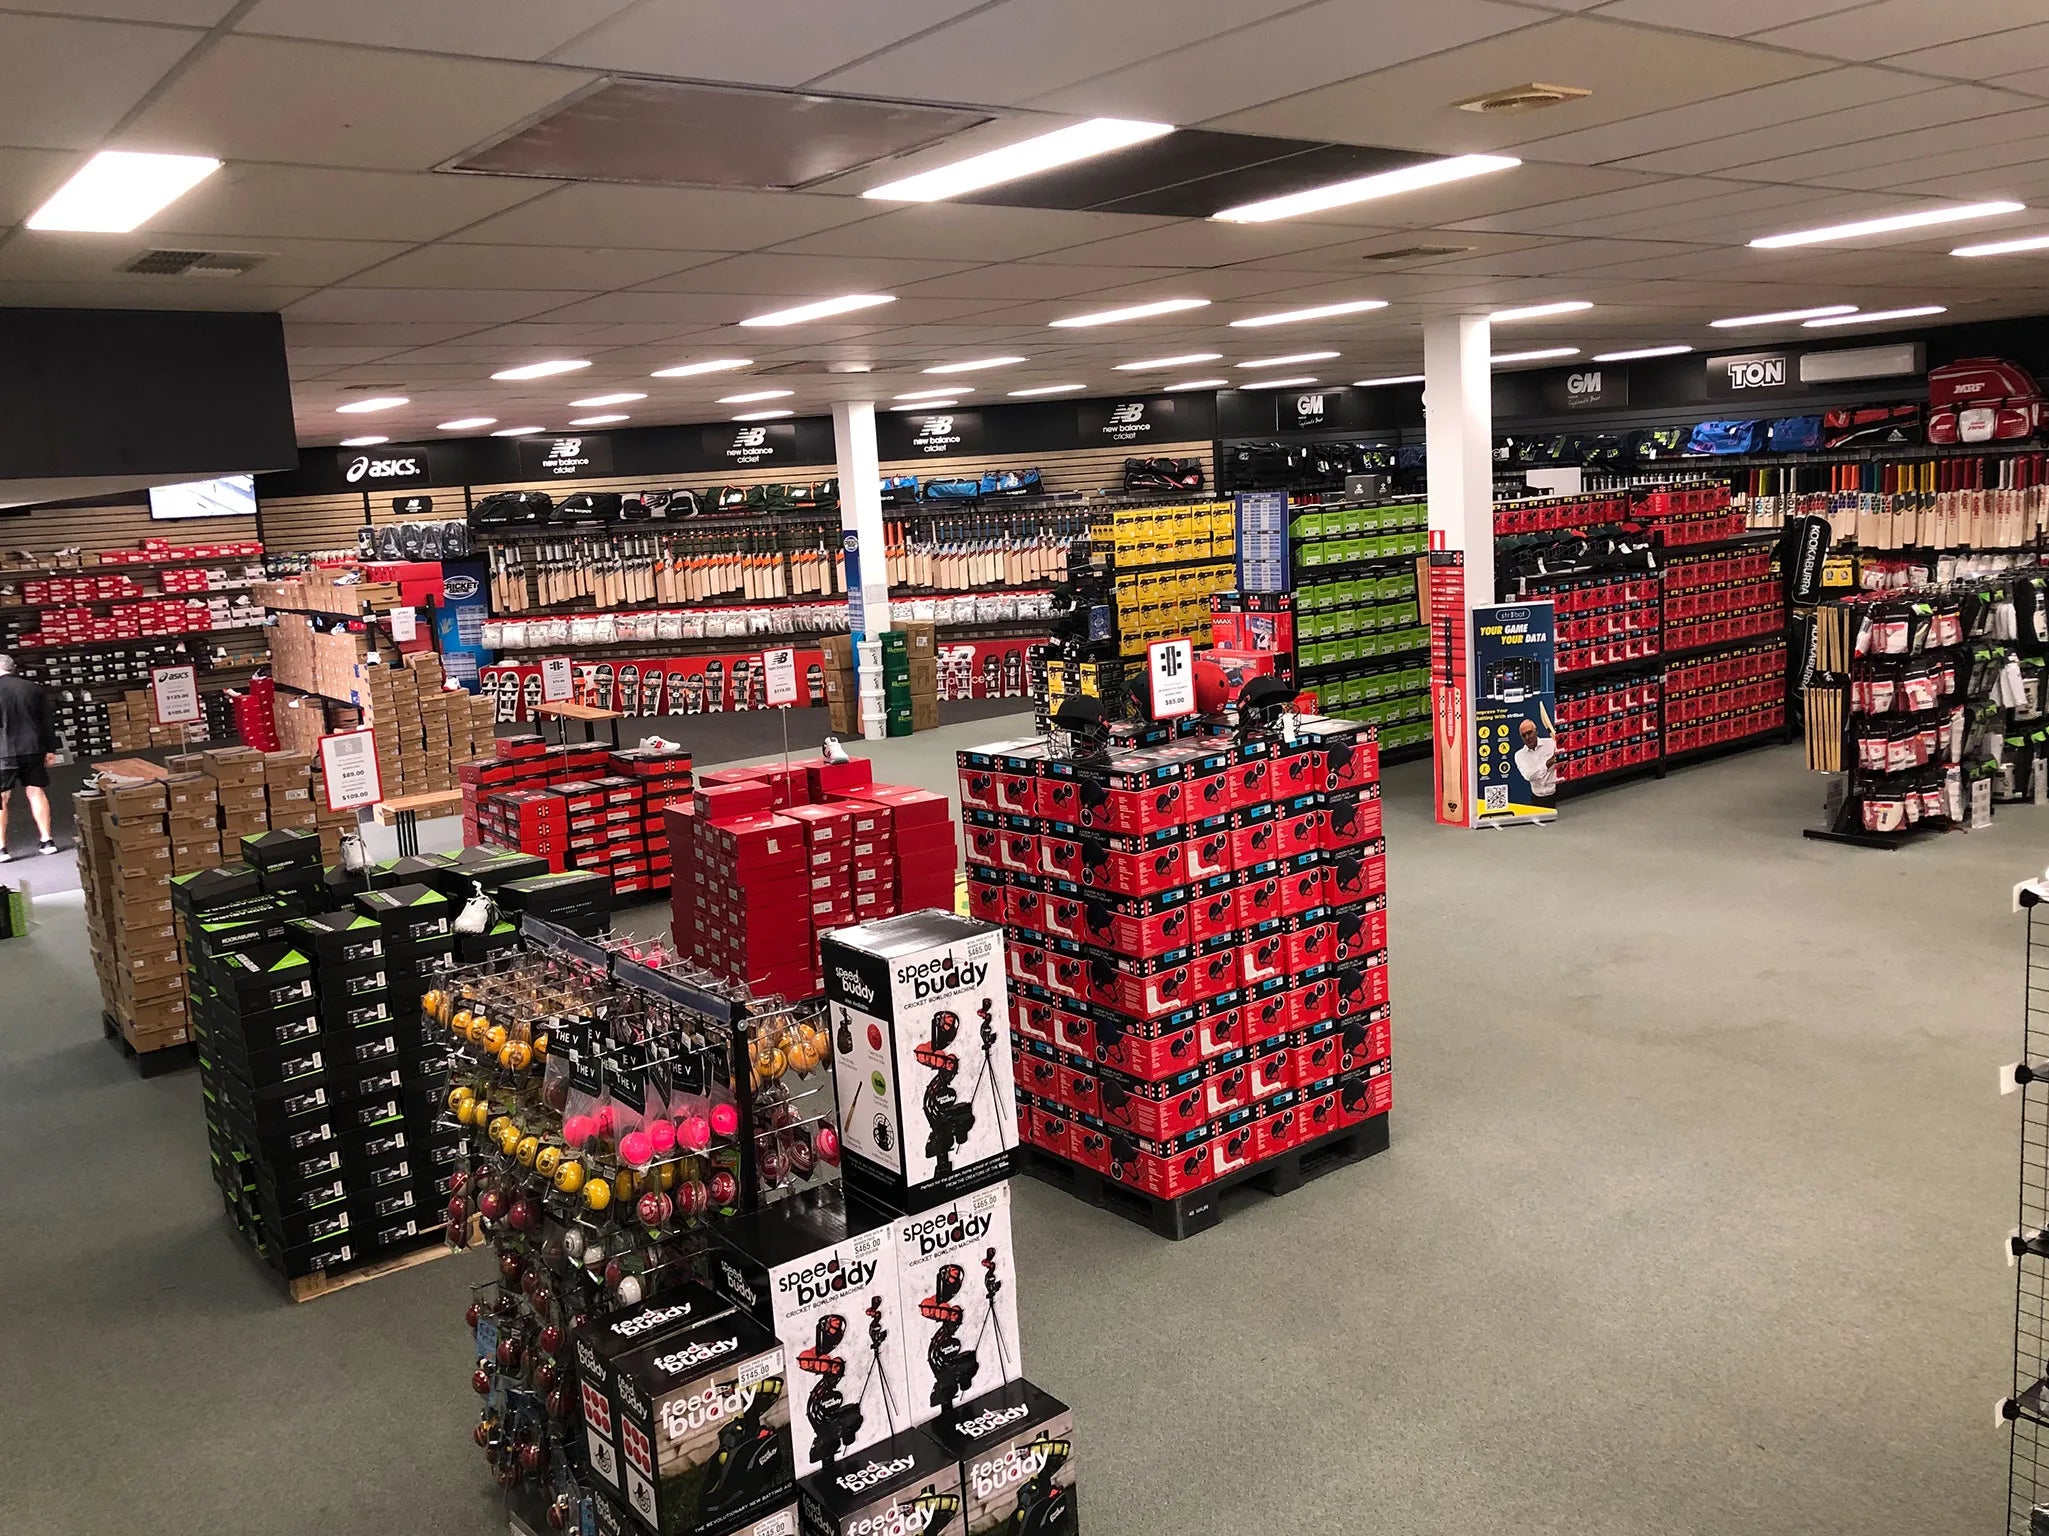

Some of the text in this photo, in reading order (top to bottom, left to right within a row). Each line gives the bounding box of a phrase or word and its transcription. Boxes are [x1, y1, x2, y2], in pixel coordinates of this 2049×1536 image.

[1567, 372, 1602, 394] GM
[1729, 358, 1785, 389] TON
[1953, 383, 1985, 394] MRF
[1297, 395, 1324, 415] GM
[1102, 424, 1151, 433] new balance
[1113, 432, 1136, 440] cricket
[726, 447, 774, 457] new balance
[913, 436, 960, 446] new balance
[924, 444, 947, 453] cricket
[542, 457, 589, 467] new balance
[553, 466, 576, 474] cricket
[737, 455, 760, 464] cricket
[1799, 525, 1820, 595] KOOKABURRA
[1480, 624, 1528, 636] YOUR GAME
[1501, 633, 1547, 645] YOUR DATA
[342, 791, 368, 801] $109.00
[222, 931, 260, 944] KOOKABURRA
[967, 943, 992, 957] $465.00
[835, 966, 859, 983] speed
[897, 948, 953, 984] speed
[842, 981, 875, 1003] buddy
[914, 962, 988, 1000] buddy
[903, 985, 976, 1010] CRICKET BOWLING MACHINE
[555, 1029, 579, 1044] THE V
[576, 1062, 595, 1078] THE V
[668, 1061, 692, 1075] THE V
[616, 1072, 637, 1092] THE V
[973, 1196, 996, 1210] $465.00
[903, 1202, 958, 1242] speed
[919, 1212, 992, 1255] buddy
[855, 1239, 880, 1254] $465.00
[908, 1236, 980, 1267] CRICKET BOWLING MACHINE
[721, 1260, 742, 1281] speed
[778, 1250, 839, 1292] speed
[798, 1258, 878, 1306] buddy
[727, 1273, 757, 1305] buddy
[785, 1285, 864, 1319] CRICKET BOWLING MACHINE
[610, 1308, 656, 1335] feed
[621, 1302, 692, 1337] buddy
[576, 1339, 594, 1361] feed
[653, 1341, 701, 1370] feed
[663, 1336, 738, 1373] buddy
[578, 1353, 607, 1382] buddy
[741, 1365, 769, 1382] $145.00
[617, 1374, 635, 1397] feed
[619, 1387, 648, 1421] buddy
[659, 1378, 716, 1430] feed
[668, 1384, 758, 1440] buddy
[955, 1409, 996, 1434] feed
[966, 1403, 1030, 1438] buddy
[847, 1454, 915, 1492] buddy
[970, 1442, 1016, 1483] feed
[978, 1447, 1050, 1499] buddy
[836, 1461, 881, 1490] feed
[694, 1482, 793, 1533] THE REVOLUTIONARY NEW BATTING AID
[847, 1498, 899, 1536] feed
